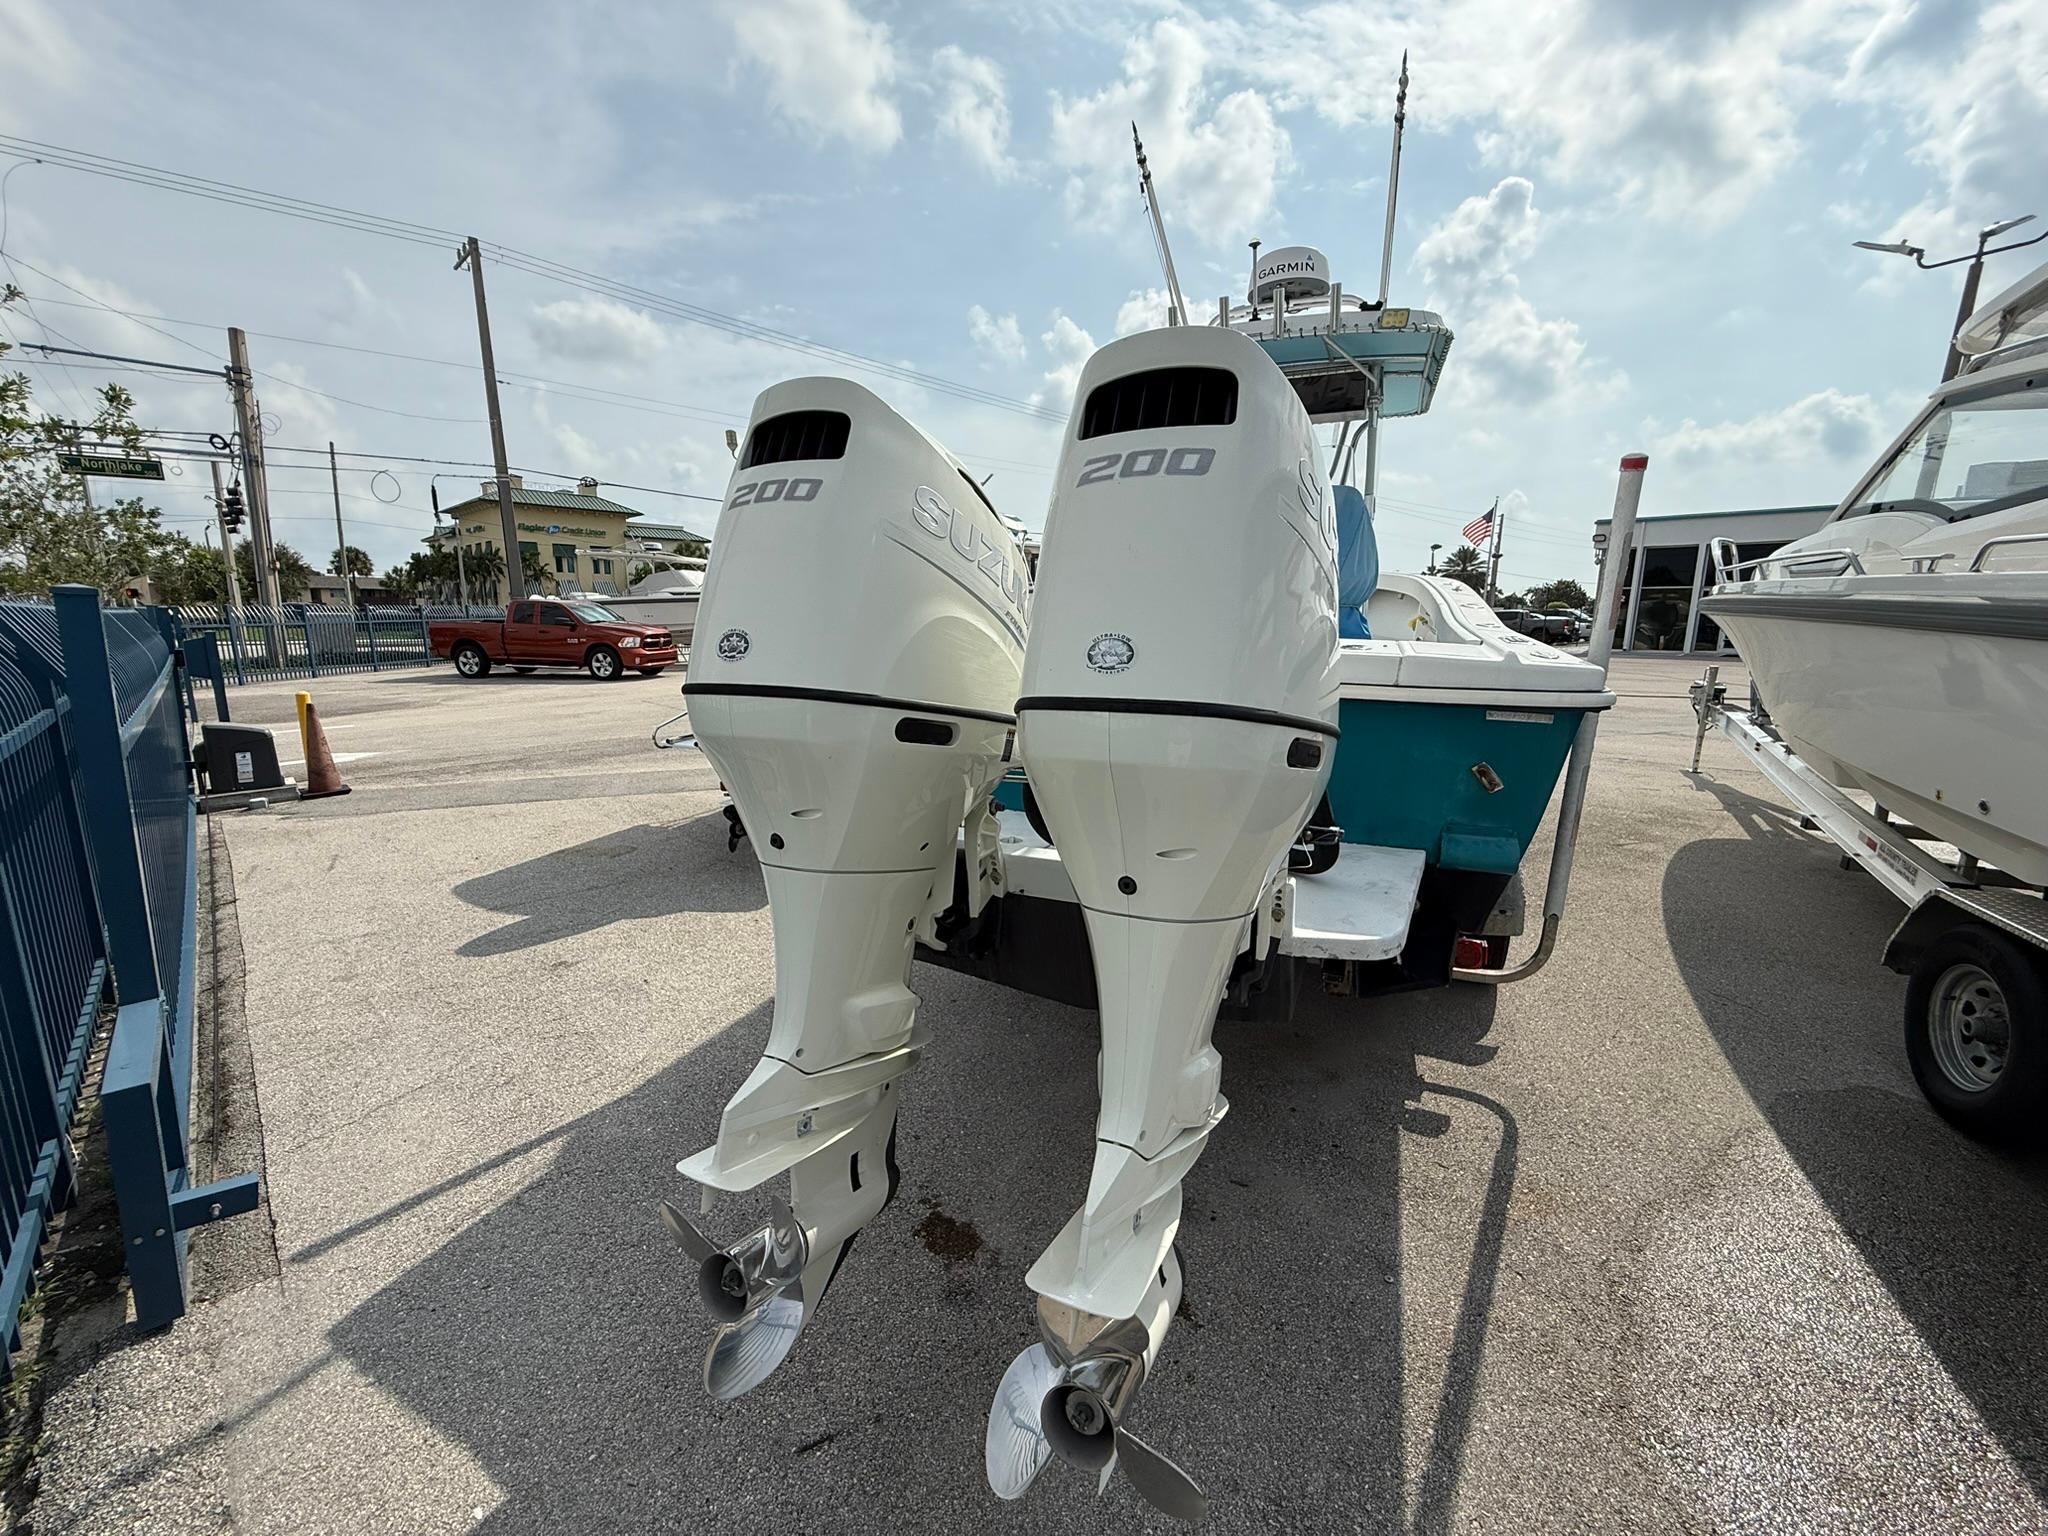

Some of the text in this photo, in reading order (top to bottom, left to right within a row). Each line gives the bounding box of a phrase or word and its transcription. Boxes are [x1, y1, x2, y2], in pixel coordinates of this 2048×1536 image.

[1258, 261, 1315, 280] GARMIN
[80, 457, 143, 472] Northlake
[1075, 447, 1217, 489] 200
[727, 477, 824, 512] 200
[561, 525, 584, 535] Credit
[585, 528, 607, 537] Union
[912, 485, 1029, 630] SUZUK
